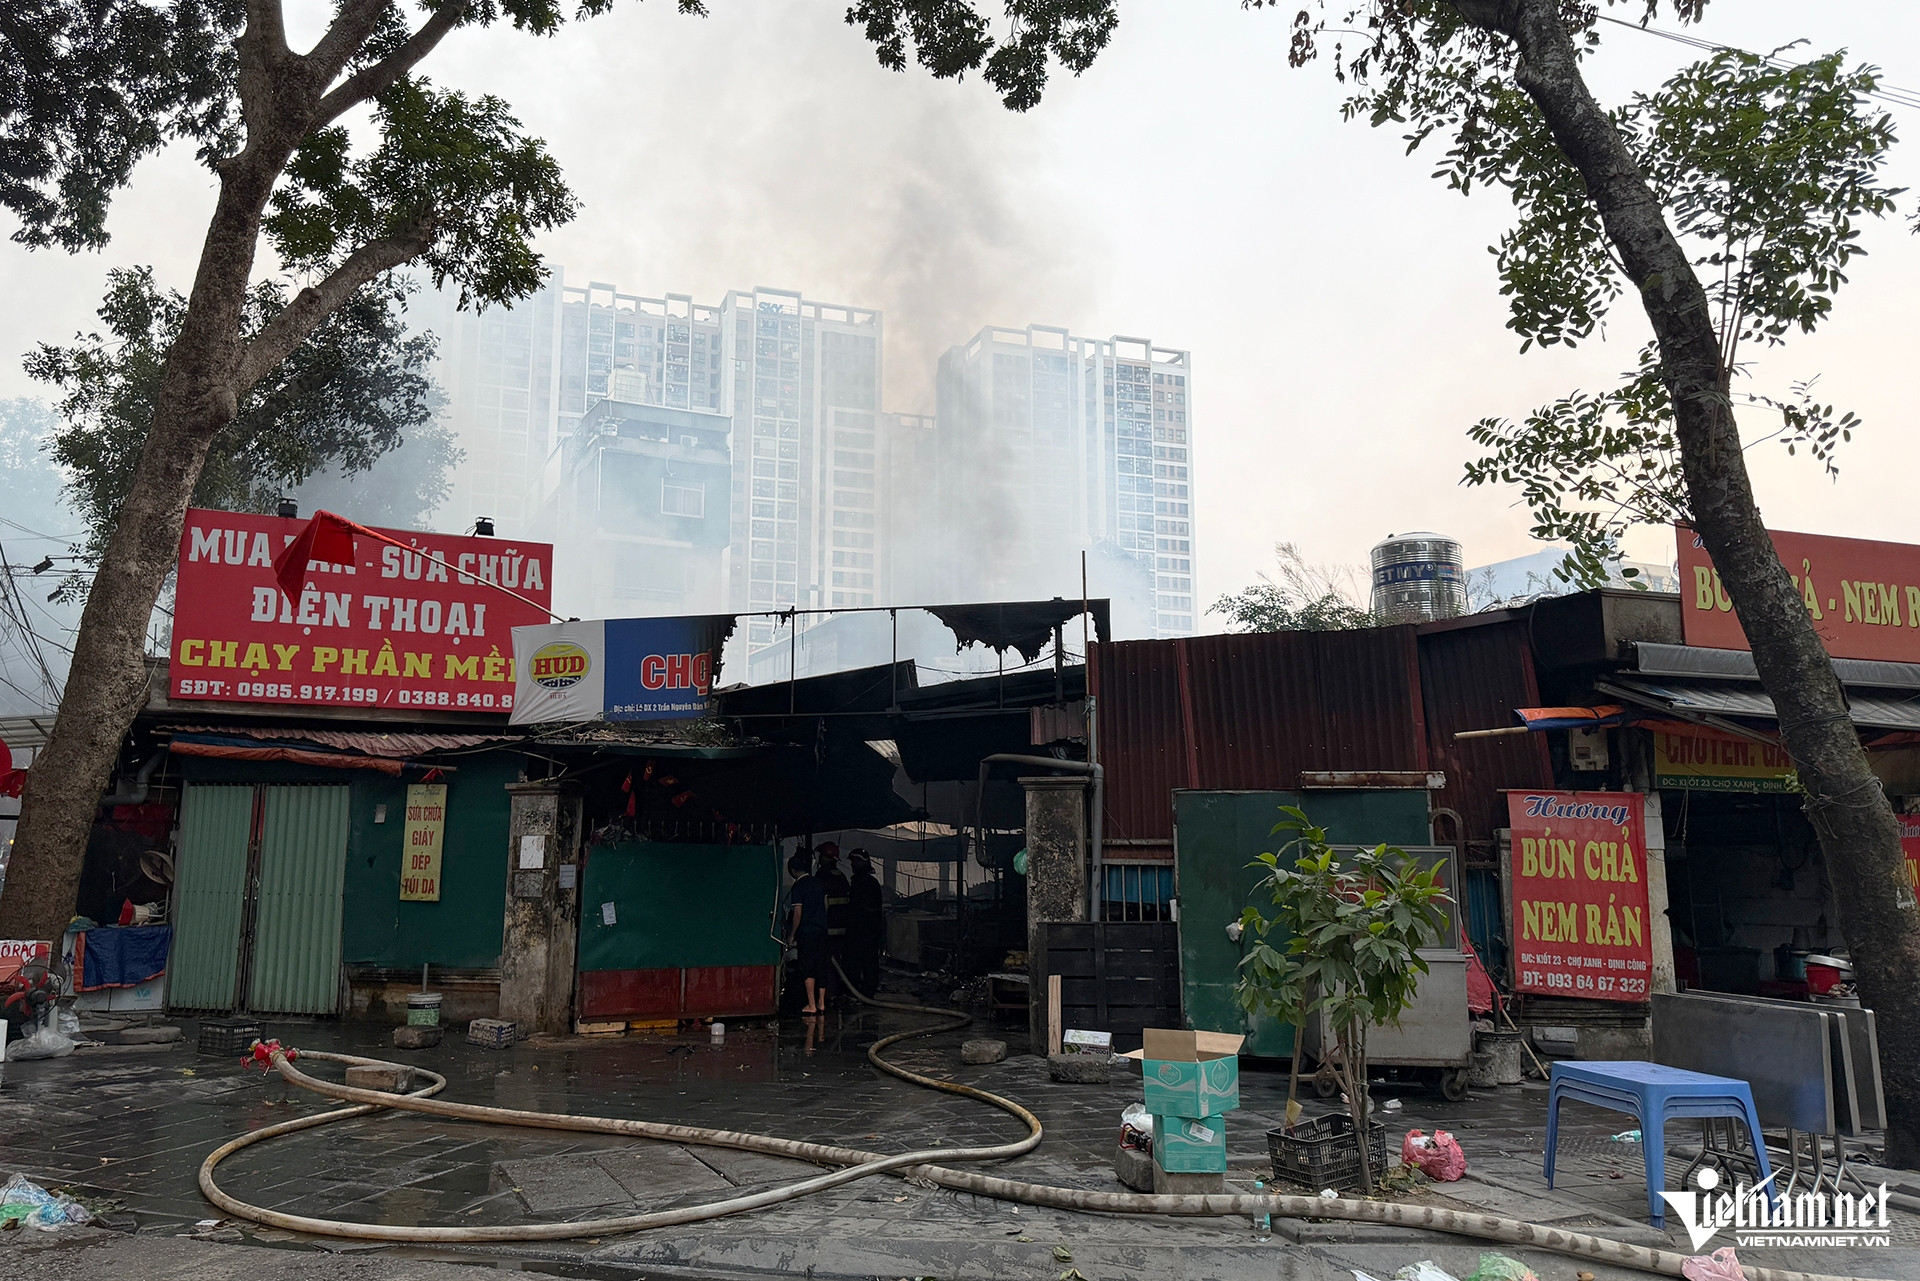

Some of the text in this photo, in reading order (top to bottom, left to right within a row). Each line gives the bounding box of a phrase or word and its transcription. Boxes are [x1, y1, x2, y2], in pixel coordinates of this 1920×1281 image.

[188, 526, 272, 568] MUA
[381, 537, 449, 583] SỬA
[457, 548, 544, 590] CHỮA
[251, 581, 486, 645] ĐIỆN THOẠI
[1841, 579, 1902, 627] NEM
[179, 637, 516, 683] CHẠY PHẦN MỀ
[534, 655, 586, 676] HUD
[641, 648, 713, 696] CHỢ
[180, 679, 231, 696] SĐT:
[237, 682, 378, 703] 0985.917.199
[1701, 779, 1711, 787] 23
[1732, 779, 1756, 788] XANH
[1523, 794, 1631, 826] Hương
[411, 851, 431, 870] DÉP
[1521, 825, 1639, 883] BÚN CHẢ
[422, 878, 435, 895] DA
[1521, 892, 1642, 947] NEM RÁN
[1552, 955, 1562, 965] 23
[1567, 955, 1582, 969] CHỢ
[1583, 957, 1603, 969] XANH
[1608, 958, 1626, 971] ĐỊNH
[1627, 958, 1647, 971] CÔNG
[1523, 970, 1646, 993] ĐT: 093 64 67 323
